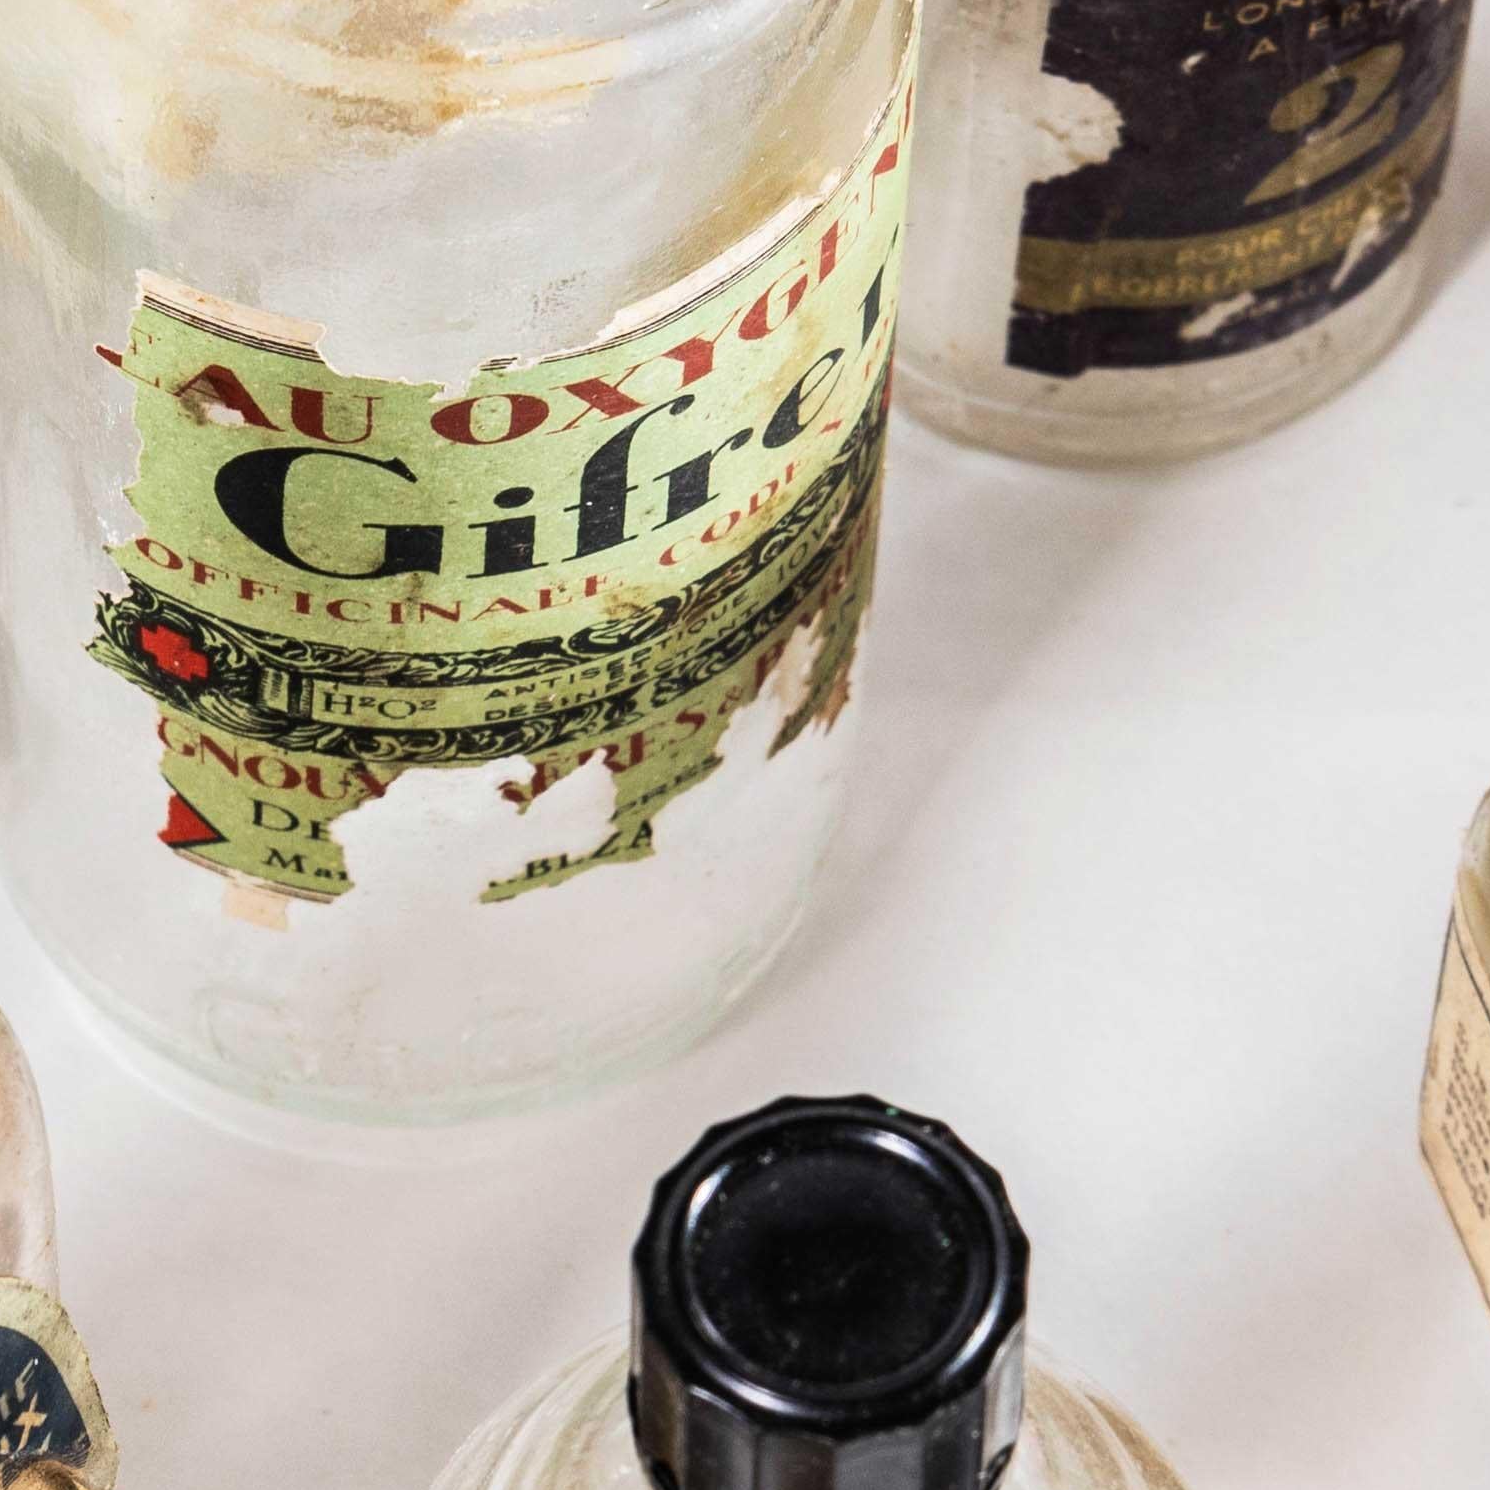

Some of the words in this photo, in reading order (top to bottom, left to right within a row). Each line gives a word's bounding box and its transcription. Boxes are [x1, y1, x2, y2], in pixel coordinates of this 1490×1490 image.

[1244, 40, 1407, 207] 2
[214, 221, 900, 581] Gifrer
[134, 536, 625, 624] OFFICINALE
[483, 592, 752, 702] ANTISEPTIQUE
